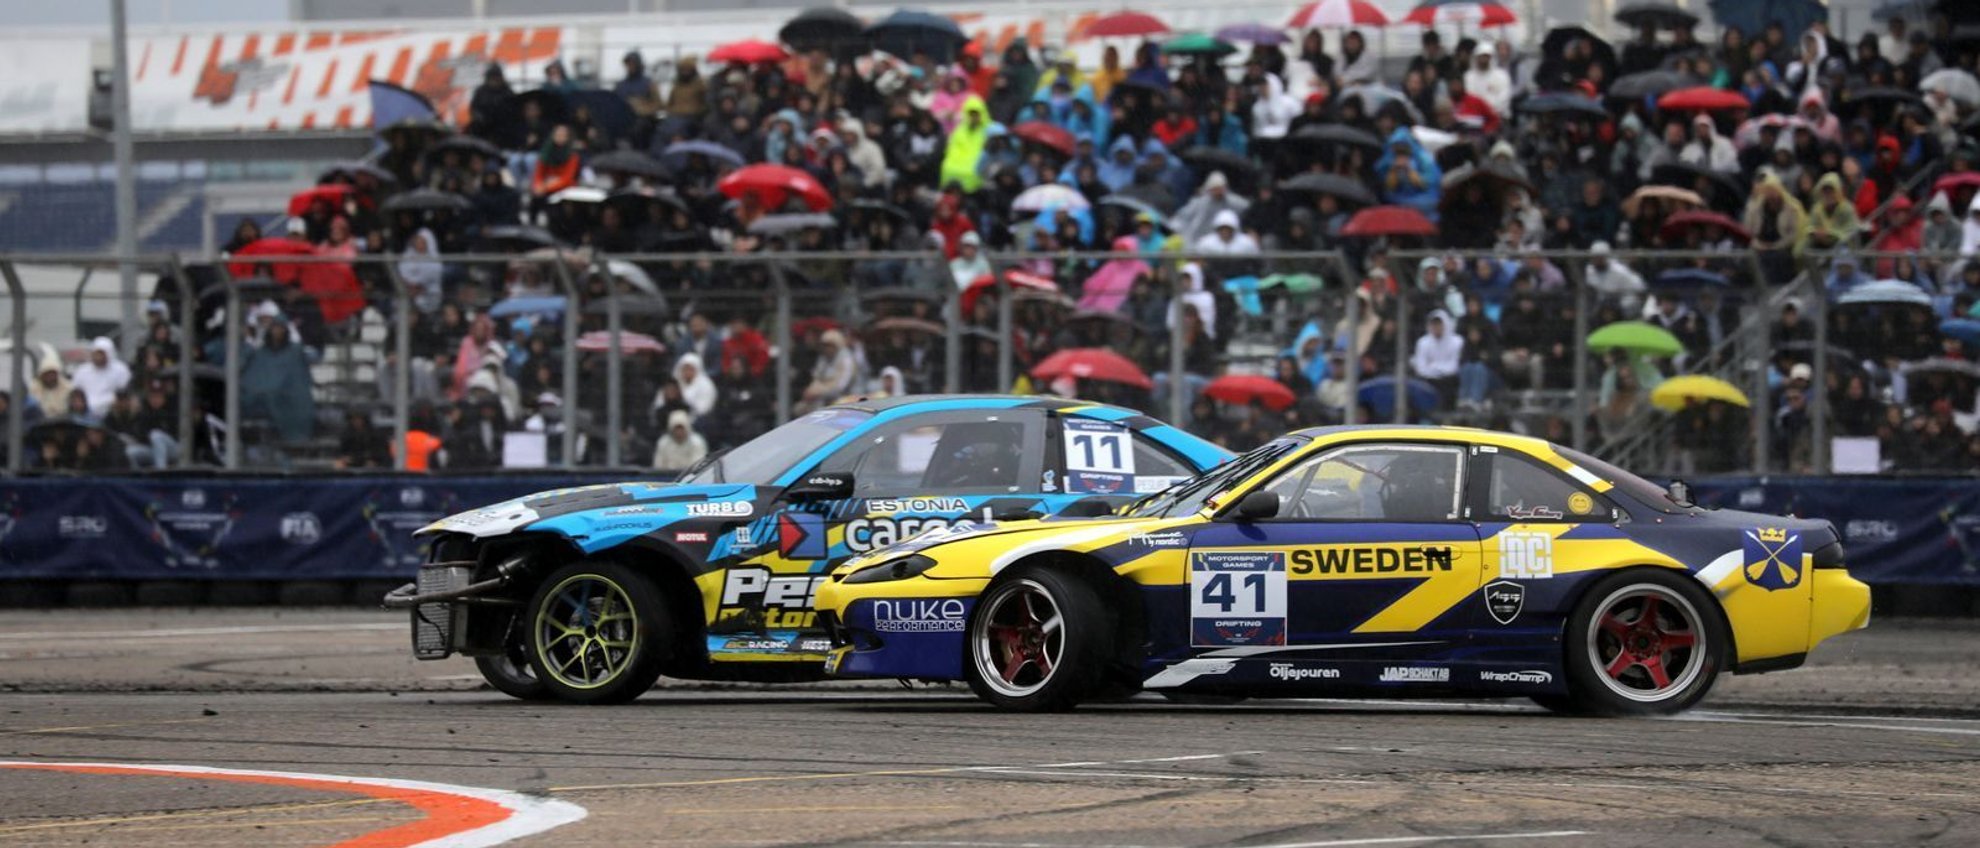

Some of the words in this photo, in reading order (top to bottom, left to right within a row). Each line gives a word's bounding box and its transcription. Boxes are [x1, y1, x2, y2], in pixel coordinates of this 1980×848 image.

[1073, 434, 1122, 469] 11
[869, 498, 969, 512] ESTONIA
[281, 516, 319, 540] FIA
[677, 533, 706, 541] MOTUL
[1291, 547, 1452, 574] SWEDEN
[1202, 573, 1266, 613] 41
[874, 599, 965, 620] nuke
[748, 641, 789, 649] RACING
[1269, 667, 1340, 680] Oljejouren
[1380, 668, 1408, 682] JAP
[1480, 671, 1546, 684] WrapChamp
